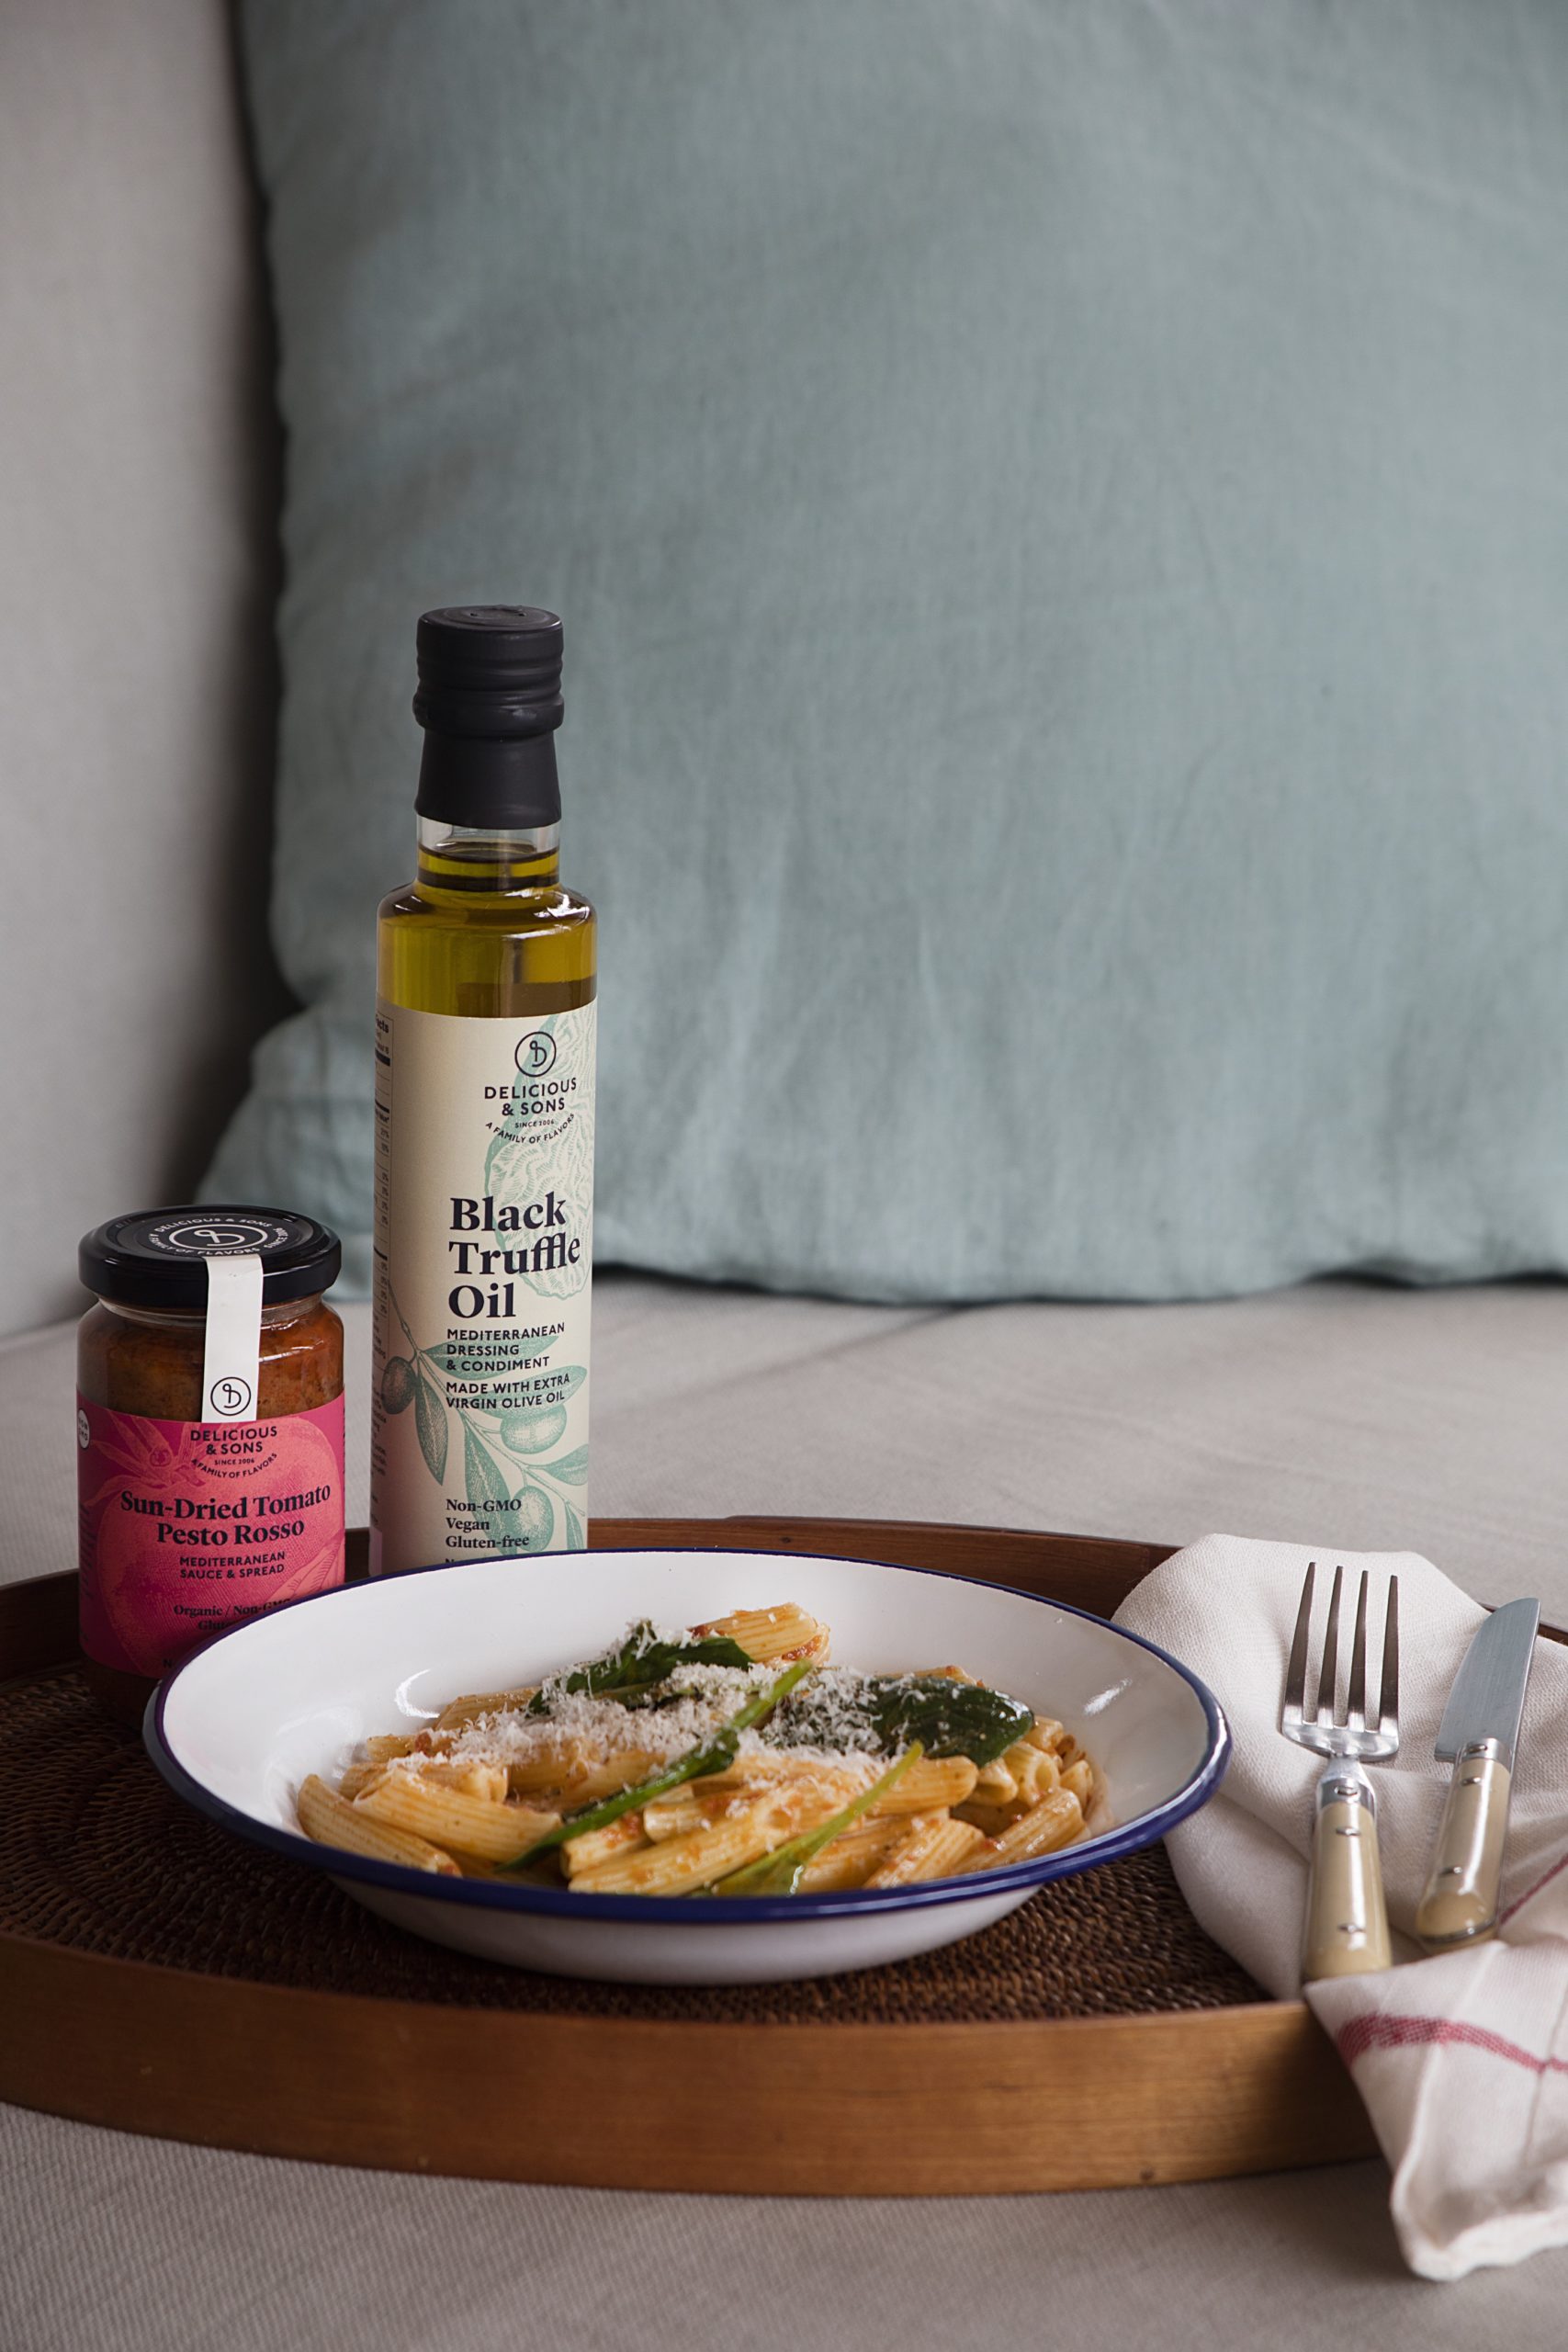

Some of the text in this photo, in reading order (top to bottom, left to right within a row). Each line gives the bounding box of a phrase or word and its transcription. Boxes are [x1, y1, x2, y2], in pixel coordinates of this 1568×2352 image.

[484, 1077, 577, 1100] DELICIOUS
[502, 1097, 565, 1116] & SONS
[493, 1126, 525, 1143] FAMILY
[528, 1136, 541, 1144] OF
[544, 1113, 575, 1141] FLAVORS
[449, 1191, 567, 1232] Black
[154, 1217, 221, 1233] DELICIOUS
[197, 1247, 261, 1256] FLAVORS
[448, 1231, 581, 1275] Truffle
[448, 1282, 516, 1318] Oil
[446, 1322, 565, 1340] MEDITERRANEAN
[446, 1344, 519, 1356] DRESSING
[446, 1356, 549, 1372] & CONDIMENT
[446, 1373, 570, 1394] MADE WITH EXTRA
[446, 1390, 565, 1409] VIRGIN OLIVE OIL
[190, 1426, 277, 1442] DELICIOUS
[206, 1441, 263, 1455] & SONS
[197, 1462, 227, 1478] FAMILY
[243, 1452, 277, 1477] FLAVORS
[120, 1485, 331, 1520] Sun-Dried Tomato
[446, 1498, 522, 1512] Non-GMO
[156, 1520, 305, 1546] Pesto Rosso
[446, 1517, 490, 1533] Vegan
[445, 1534, 530, 1549] Gluten-free
[179, 1551, 286, 1567] MEDITERRANEAN
[180, 1564, 285, 1579] SAUCE & SPREAD
[174, 1604, 223, 1618] Organic
